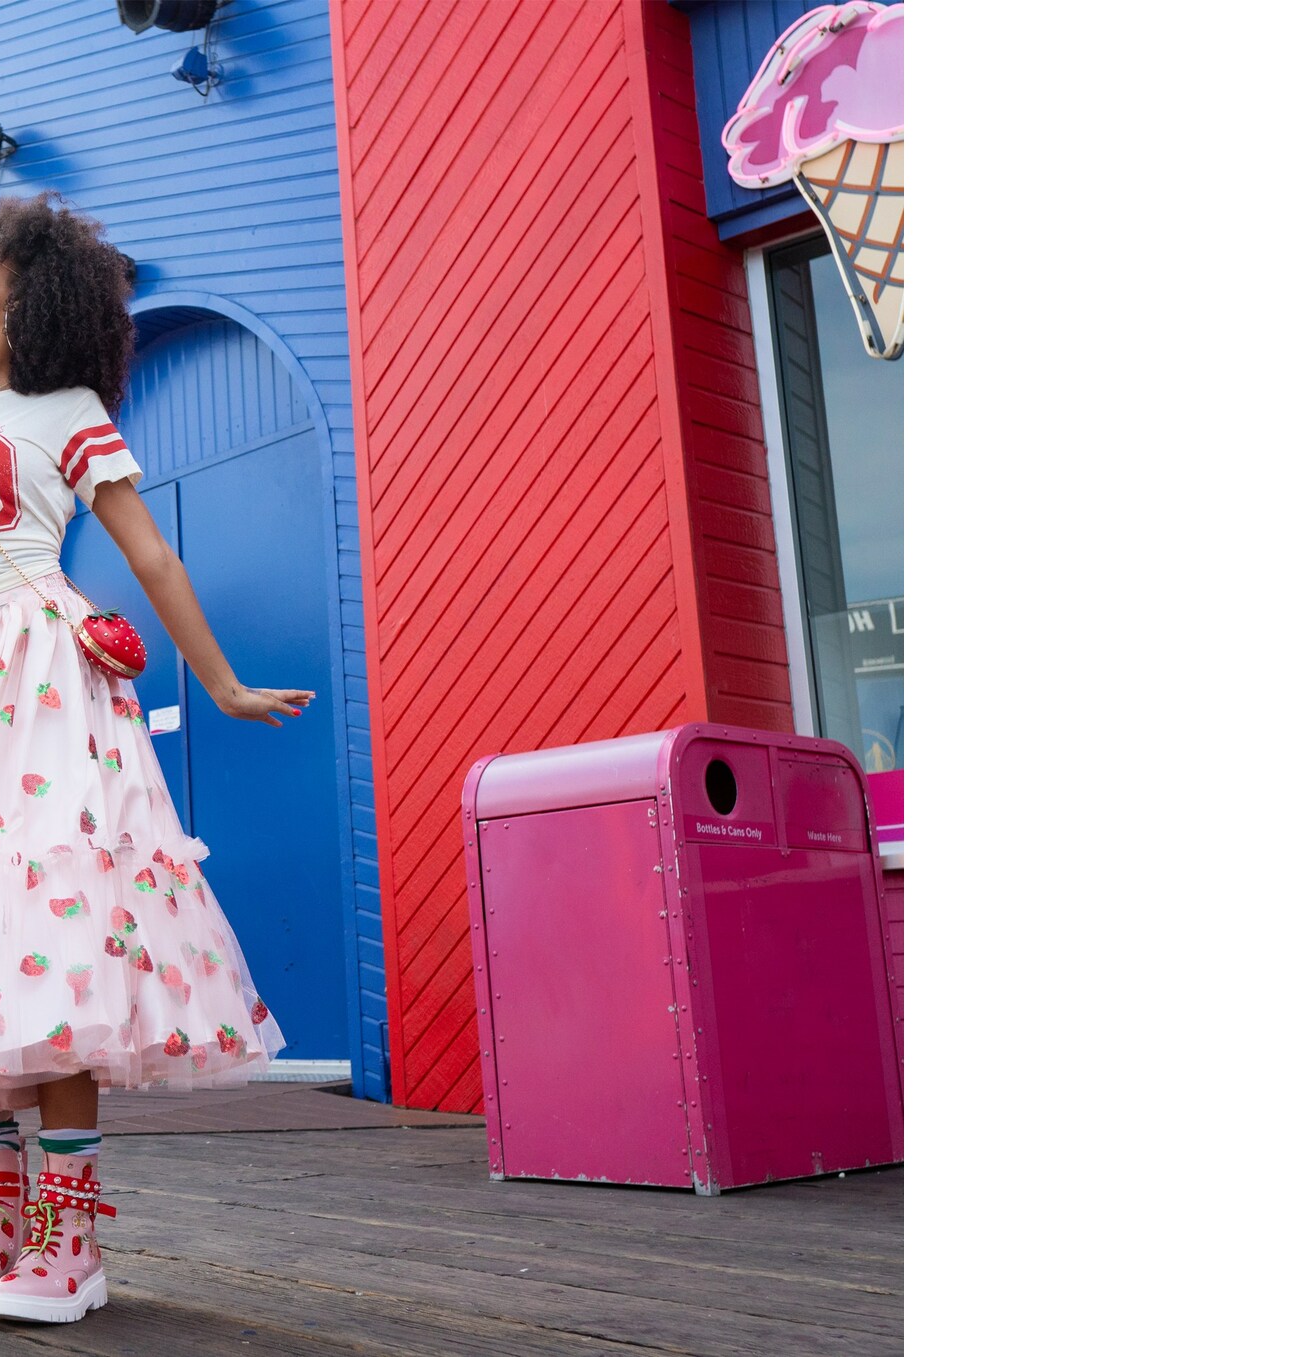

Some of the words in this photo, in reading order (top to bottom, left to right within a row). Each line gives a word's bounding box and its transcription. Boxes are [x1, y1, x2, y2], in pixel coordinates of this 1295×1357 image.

[696, 822, 721, 835] Bottles
[721, 825, 726, 835] &
[727, 826, 745, 837] Cans
[746, 827, 762, 840] Only
[807, 831, 827, 841] Waste
[827, 832, 842, 843] Here
